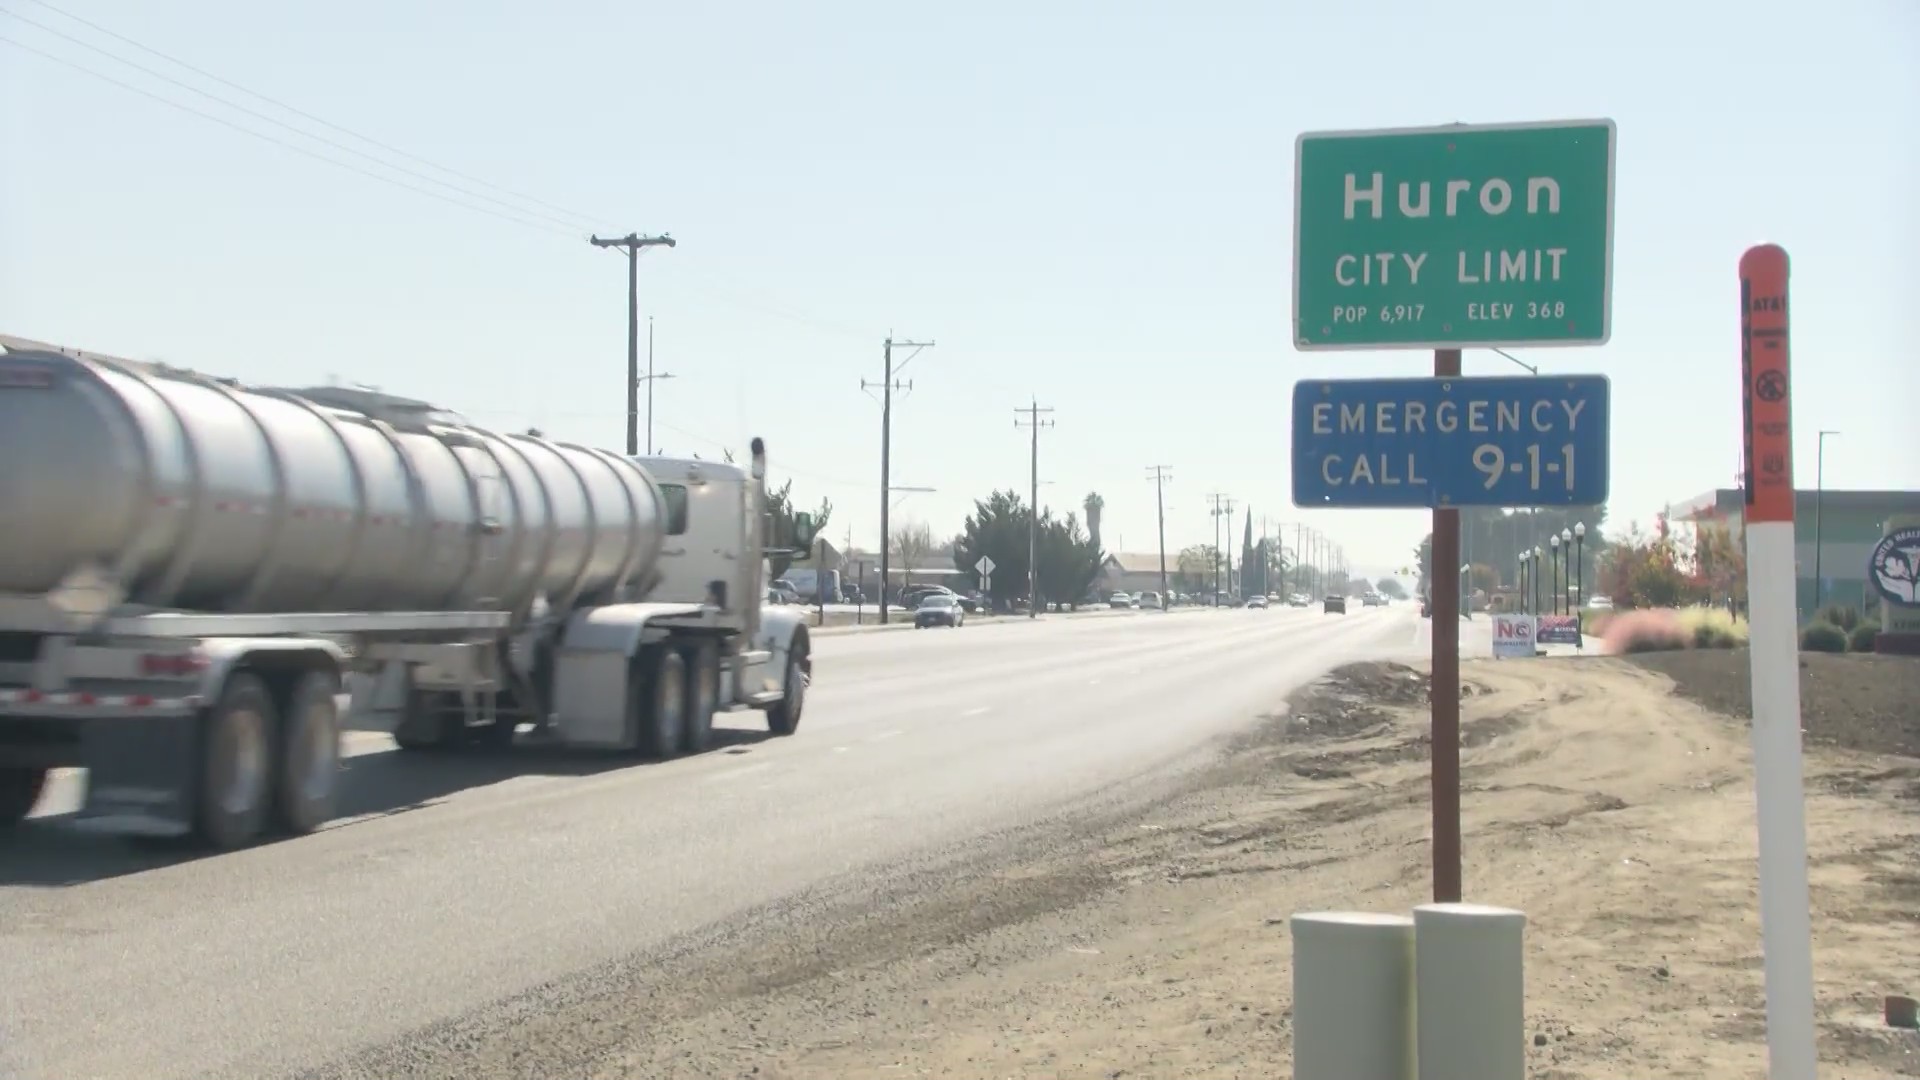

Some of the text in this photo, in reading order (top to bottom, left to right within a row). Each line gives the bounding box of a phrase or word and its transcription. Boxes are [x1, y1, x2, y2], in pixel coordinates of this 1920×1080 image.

[1343, 172, 1561, 219] Huron
[1334, 248, 1567, 286] CITY LIMIT
[1333, 301, 1566, 324] POP 6,917 ELEV 368
[1311, 399, 1586, 435] EMERGENCY
[1321, 443, 1576, 490] CALL 9-1-1
